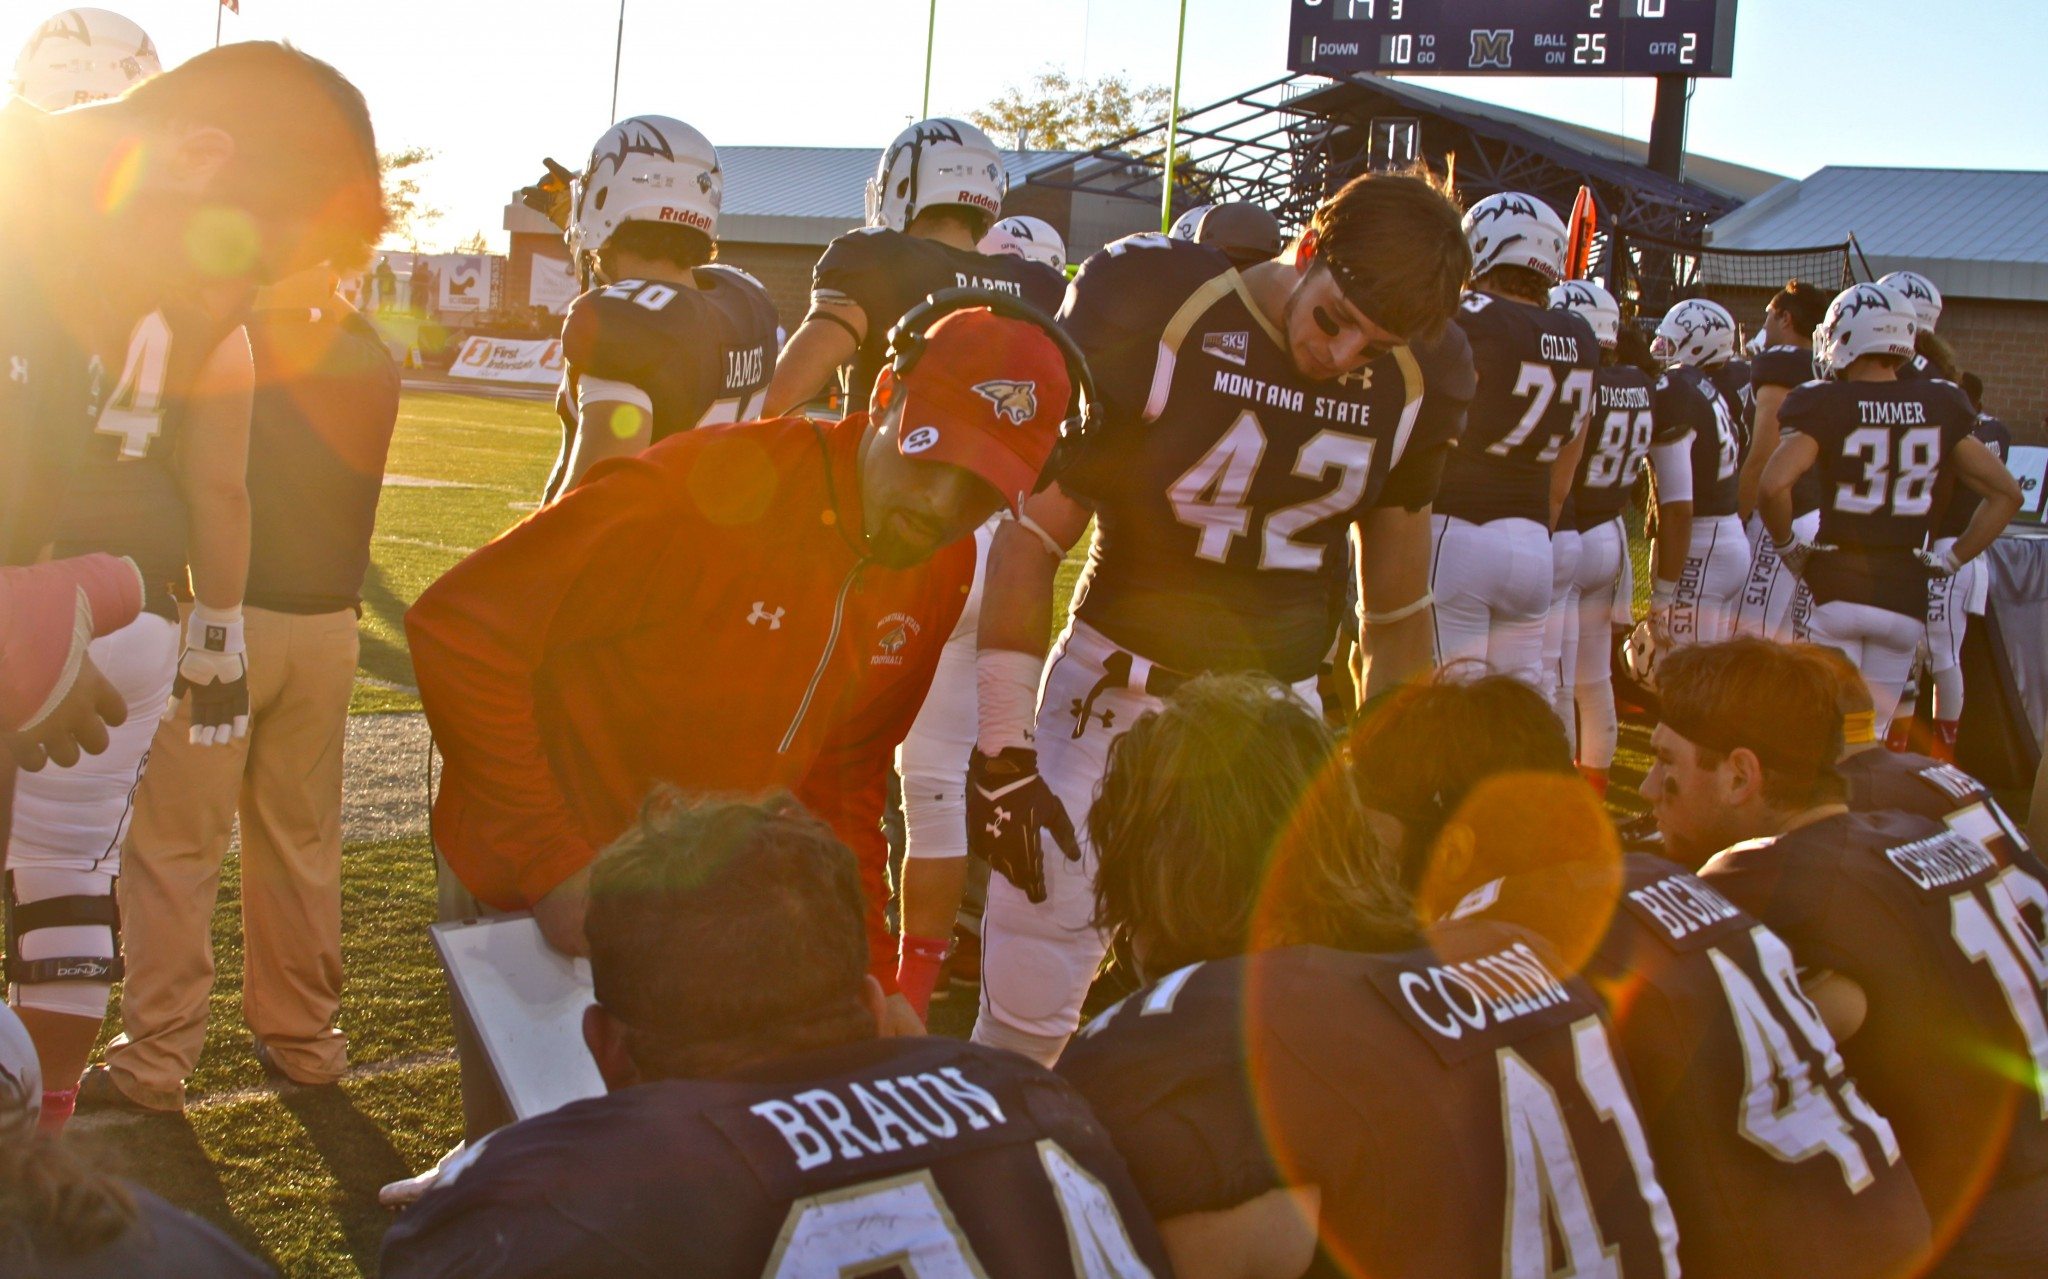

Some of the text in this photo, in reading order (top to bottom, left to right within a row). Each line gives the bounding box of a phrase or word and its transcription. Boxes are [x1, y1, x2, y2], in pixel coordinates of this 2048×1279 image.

[1318, 44, 1358, 55] DOWN
[1391, 35, 1411, 64] 10
[1419, 35, 1435, 47] TO
[1534, 34, 1567, 46] BALL
[1574, 33, 1606, 64] 25
[1649, 42, 1676, 55] QTR
[1679, 33, 1696, 64] 2
[1417, 52, 1435, 63] GO
[1545, 52, 1565, 63] ON
[957, 190, 999, 213] Riddell
[659, 206, 712, 230] Riddell
[600, 278, 678, 311] 20
[1540, 333, 1578, 363] GILLIS
[726, 346, 763, 388] JAMES
[95, 309, 173, 461] 4
[1213, 370, 1370, 426] MONTANA STATE
[1600, 385, 1649, 408] D'AGOSTINO
[1485, 361, 1594, 463] 73
[1858, 401, 1926, 425] TIMMER
[1583, 410, 1653, 488] 88
[1833, 426, 1941, 517] 38
[1165, 409, 1377, 572] 42
[751, 1066, 1007, 1171] BRAUN
